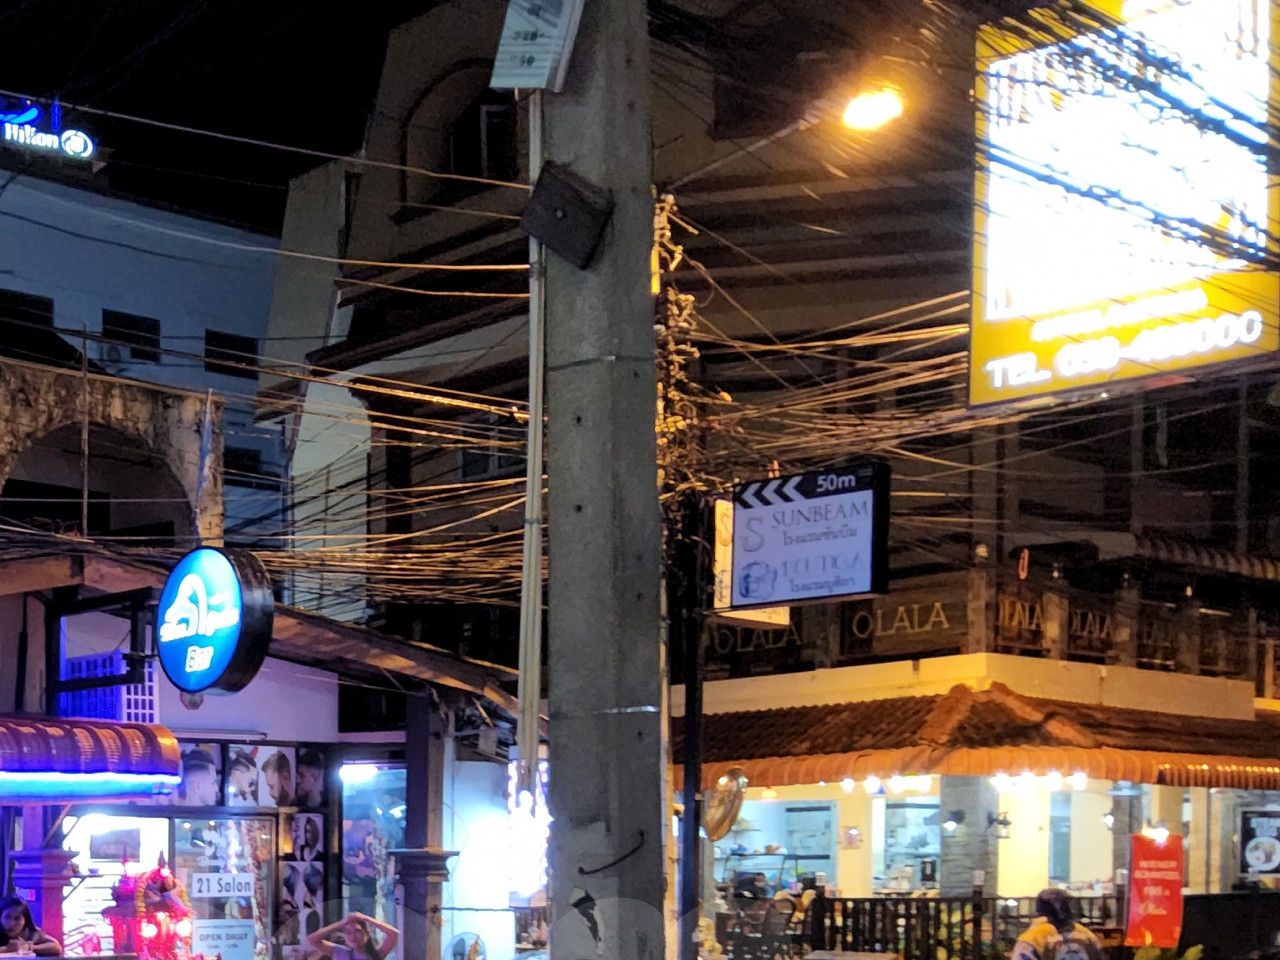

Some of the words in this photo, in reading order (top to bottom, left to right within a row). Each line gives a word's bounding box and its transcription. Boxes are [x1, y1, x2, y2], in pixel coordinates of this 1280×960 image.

[4, 122, 60, 149] Hilton
[816, 473, 856, 492] 50m
[771, 500, 869, 530] SUNBEAM
[852, 602, 950, 638] OLALA
[197, 877, 210, 893] 21
[217, 876, 251, 893] Salon
[199, 932, 222, 941] OPEN
